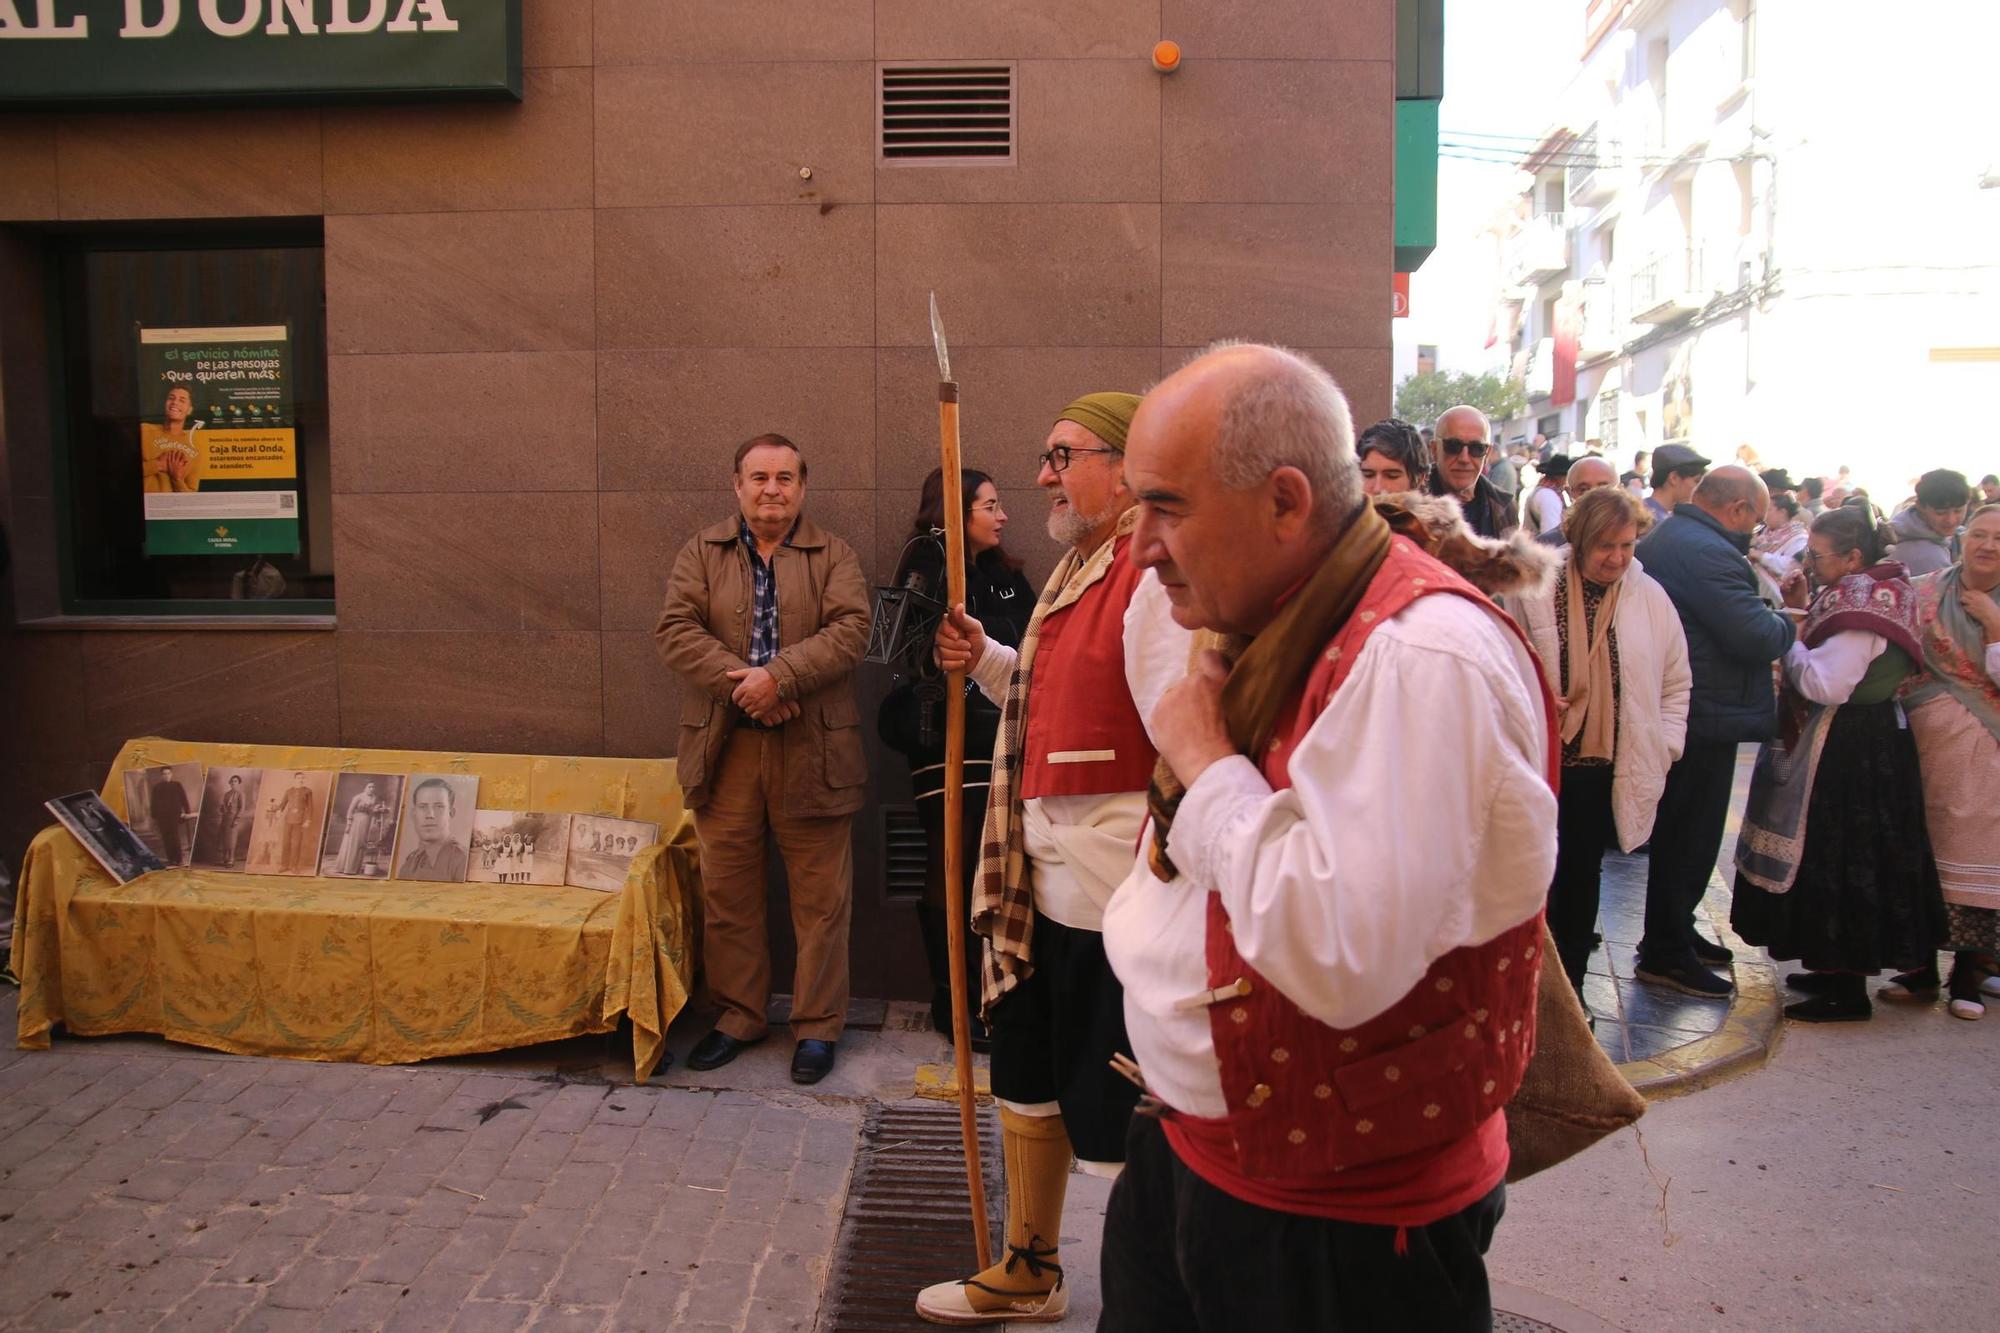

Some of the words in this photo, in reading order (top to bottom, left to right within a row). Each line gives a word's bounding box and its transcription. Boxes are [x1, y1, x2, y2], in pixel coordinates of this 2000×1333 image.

[182, 347, 230, 361] servicio
[233, 346, 280, 359] nómina
[195, 370, 245, 384] quieren
[209, 444, 229, 455] Caja
[231, 444, 257, 453] Rural
[258, 443, 286, 454] Onda,
